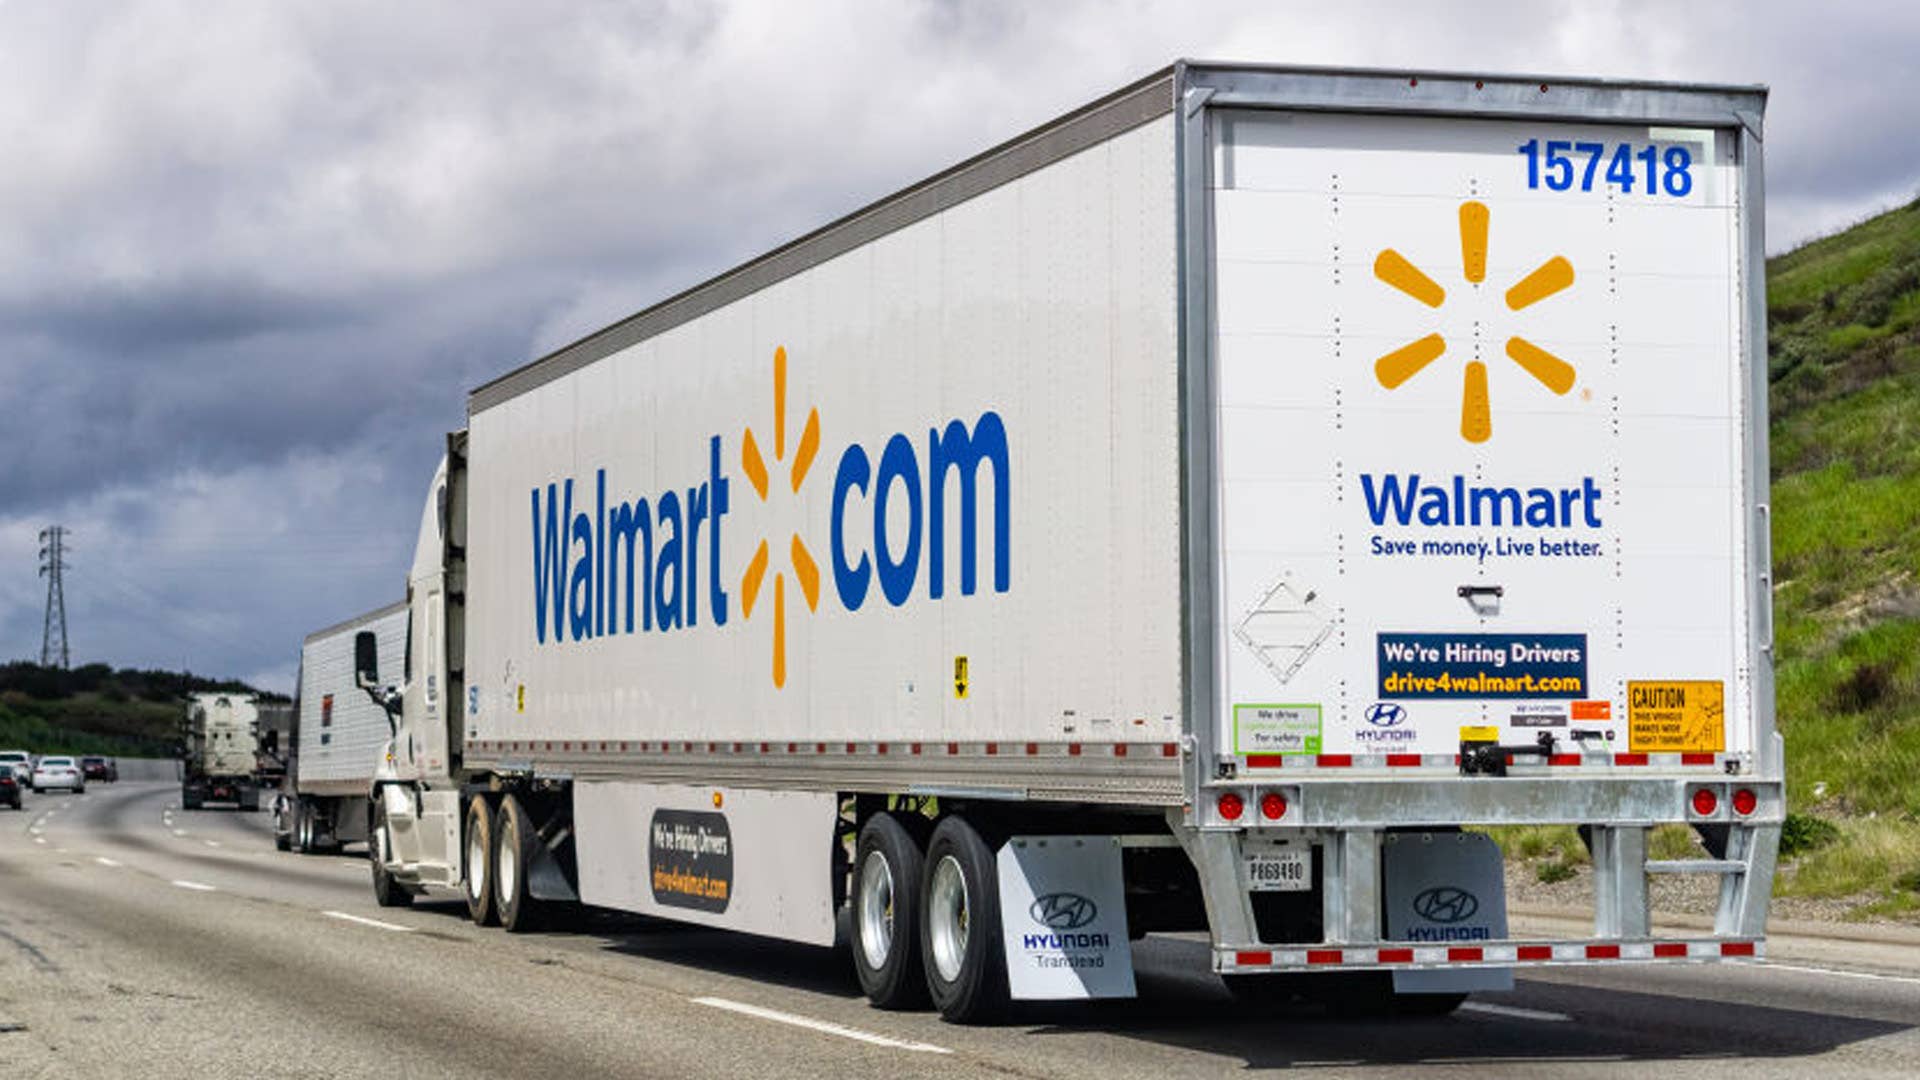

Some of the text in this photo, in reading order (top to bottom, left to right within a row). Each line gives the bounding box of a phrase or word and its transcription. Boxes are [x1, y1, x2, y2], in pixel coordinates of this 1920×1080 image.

[1518, 138, 1692, 197] 157418
[1360, 474, 1602, 528] Walmart
[530, 410, 1010, 645] Walmart com
[1371, 535, 1603, 561] Save money. Live better.
[1384, 642, 1581, 668] We're Hiring Drivers
[1384, 672, 1581, 692] drive4walmart.com
[1633, 688, 1685, 709] CAUTION
[1355, 730, 1416, 741] HYUNDAI
[1024, 934, 1109, 949] HYUNDAI
[1408, 927, 1489, 941] HYUNDAI
